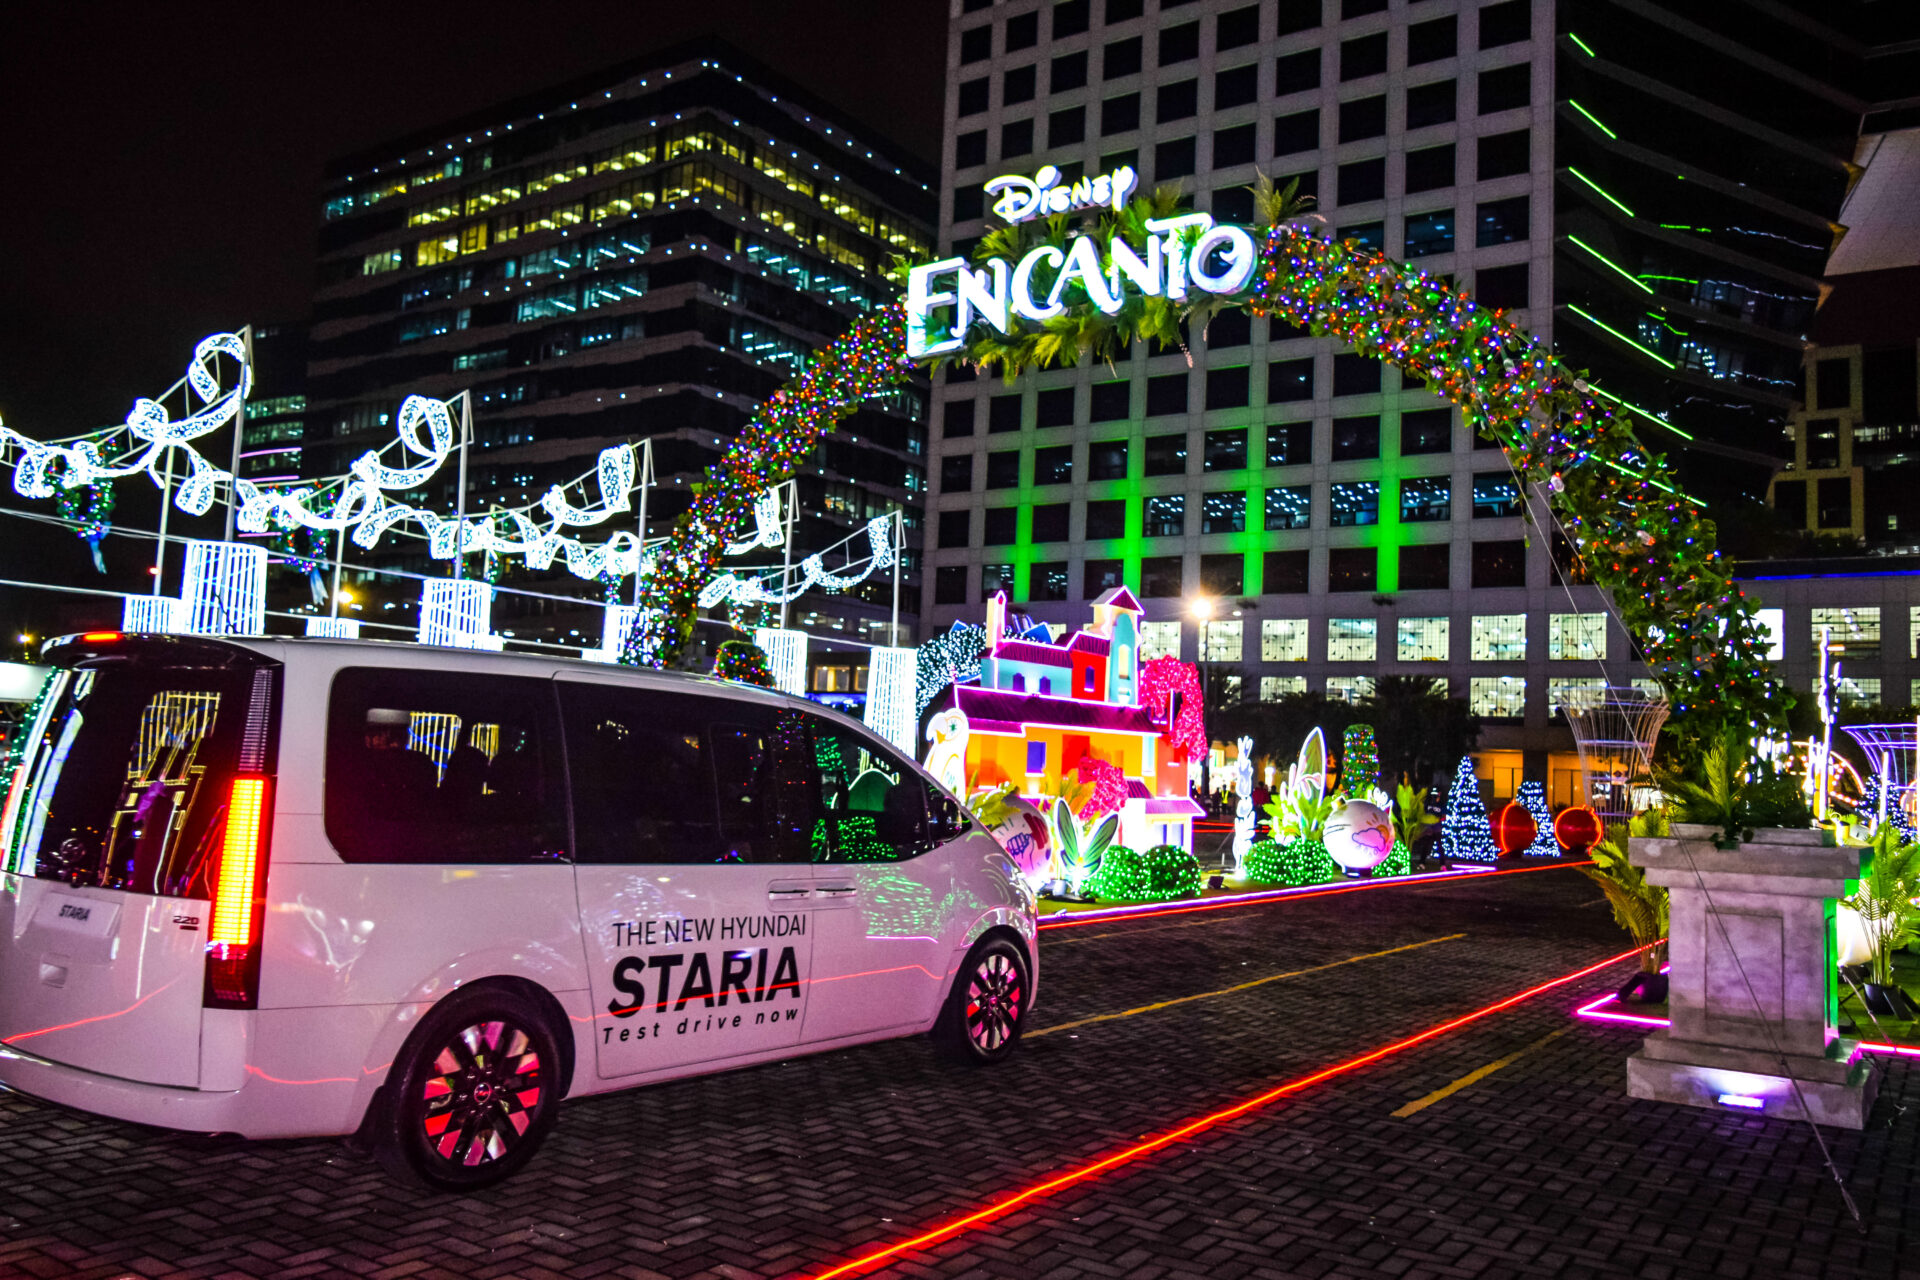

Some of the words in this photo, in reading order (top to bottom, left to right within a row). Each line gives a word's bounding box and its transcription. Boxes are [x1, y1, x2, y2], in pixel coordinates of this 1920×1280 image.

[905, 213, 1258, 357] ENCANTO
[59, 904, 91, 921] STARIA
[612, 920, 657, 946] THE
[664, 918, 715, 943] NEW
[721, 914, 806, 940] HYUNDAI
[608, 946, 800, 1019] STARIA
[603, 1022, 660, 1044] Test
[676, 1014, 742, 1035] drive
[755, 1008, 798, 1025] now
